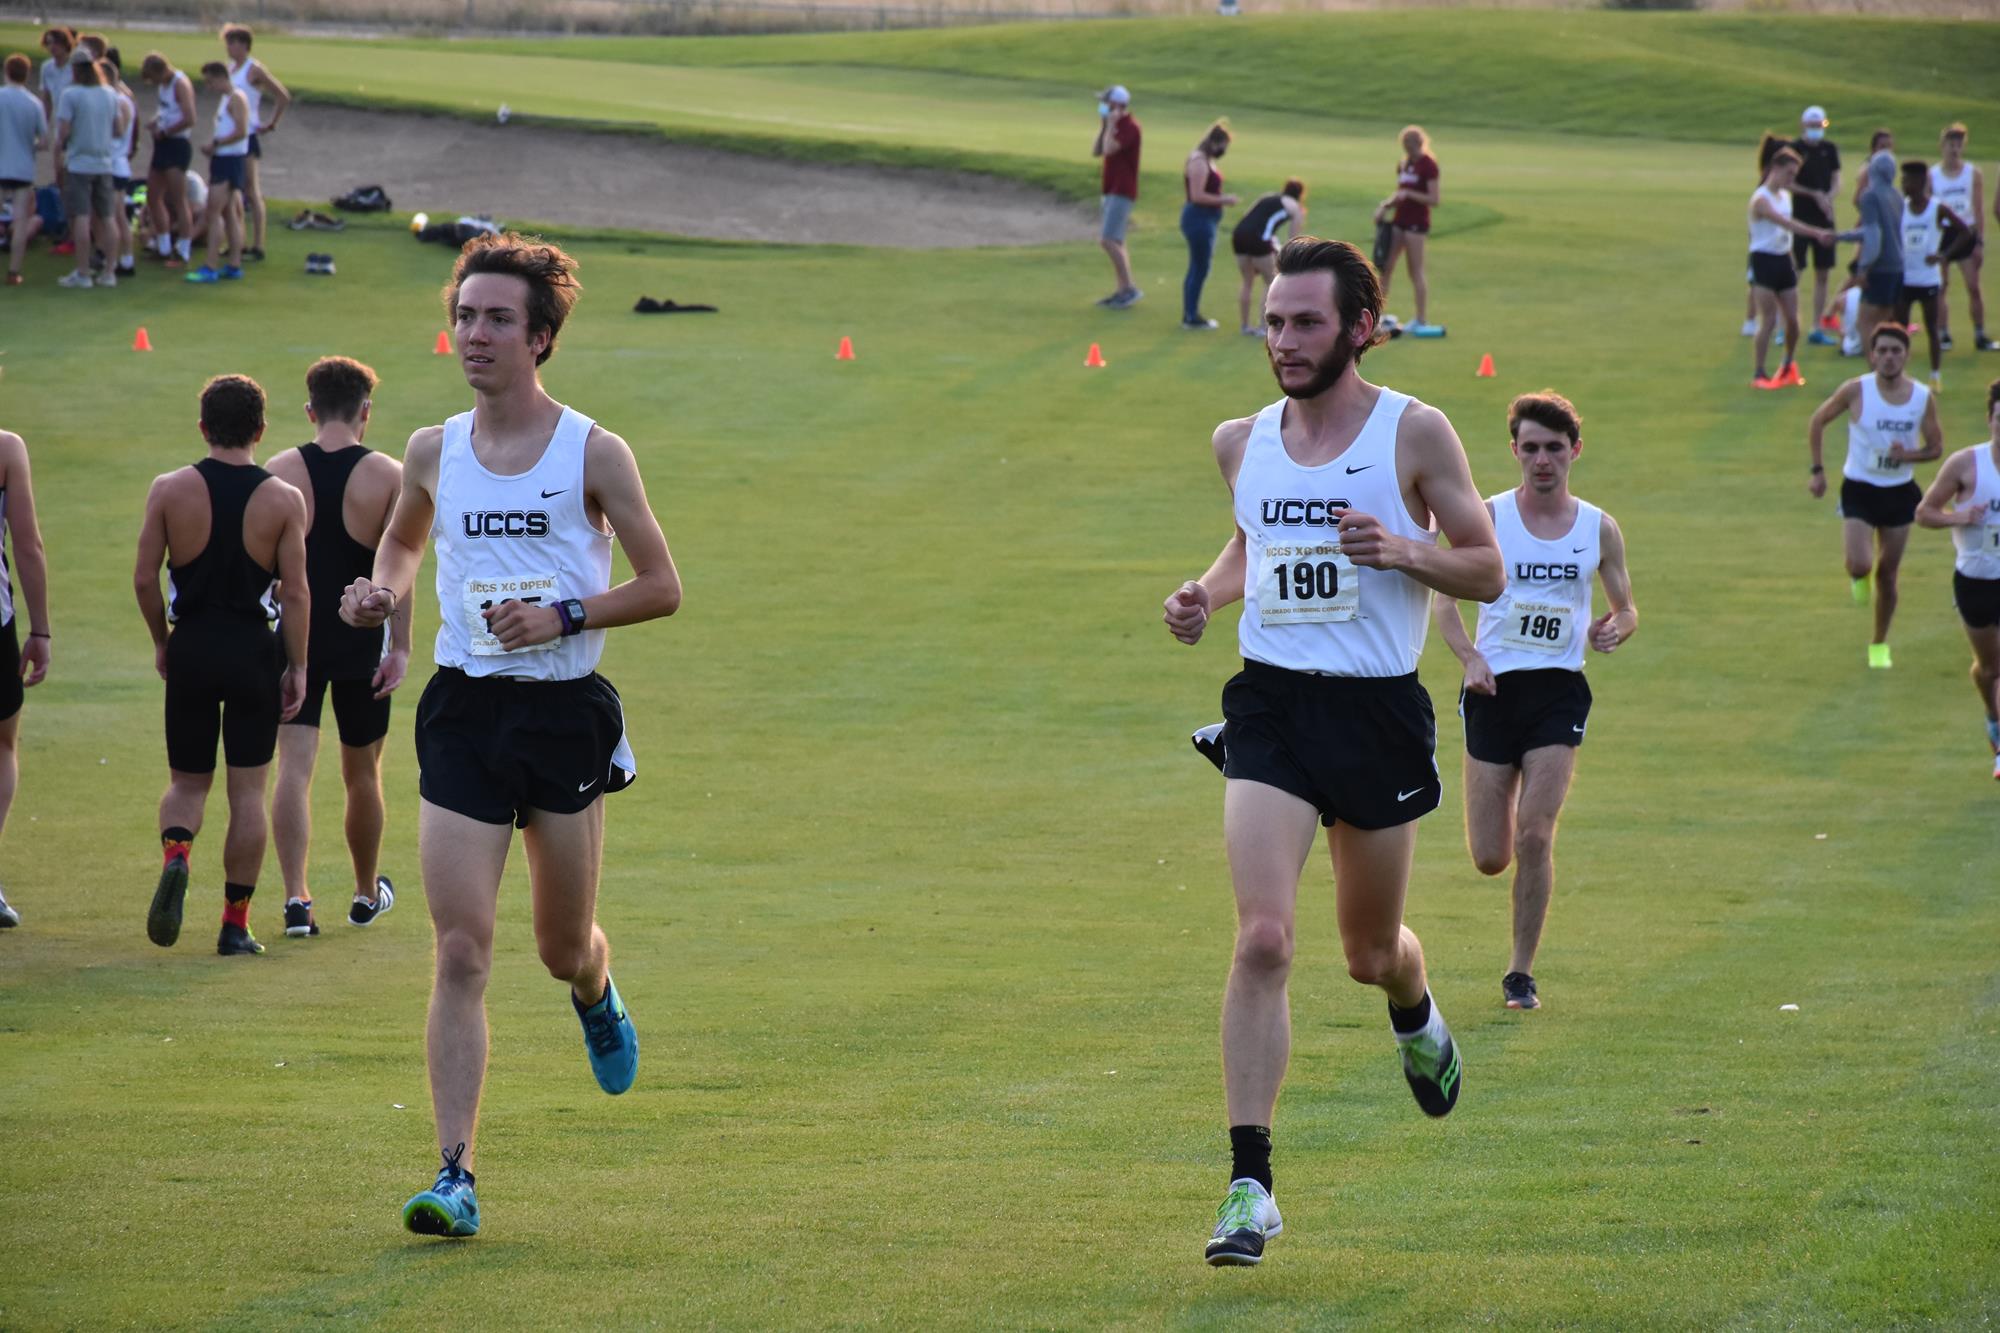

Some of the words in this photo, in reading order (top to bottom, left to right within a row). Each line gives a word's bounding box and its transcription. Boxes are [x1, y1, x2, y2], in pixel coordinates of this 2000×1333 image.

[1261, 498, 1352, 527] UCCS
[462, 510, 550, 539] UCCS
[1266, 547, 1292, 558] UCCS
[1295, 546, 1312, 556] XC
[1315, 545, 1343, 556] OPE
[1274, 561, 1338, 600] 190
[1516, 563, 1579, 580] UCCS
[469, 582, 497, 594] UCCS
[501, 582, 517, 592] XC
[520, 579, 552, 591] OPEN
[1322, 605, 1355, 614] COMPANY
[1520, 615, 1561, 640] 196
